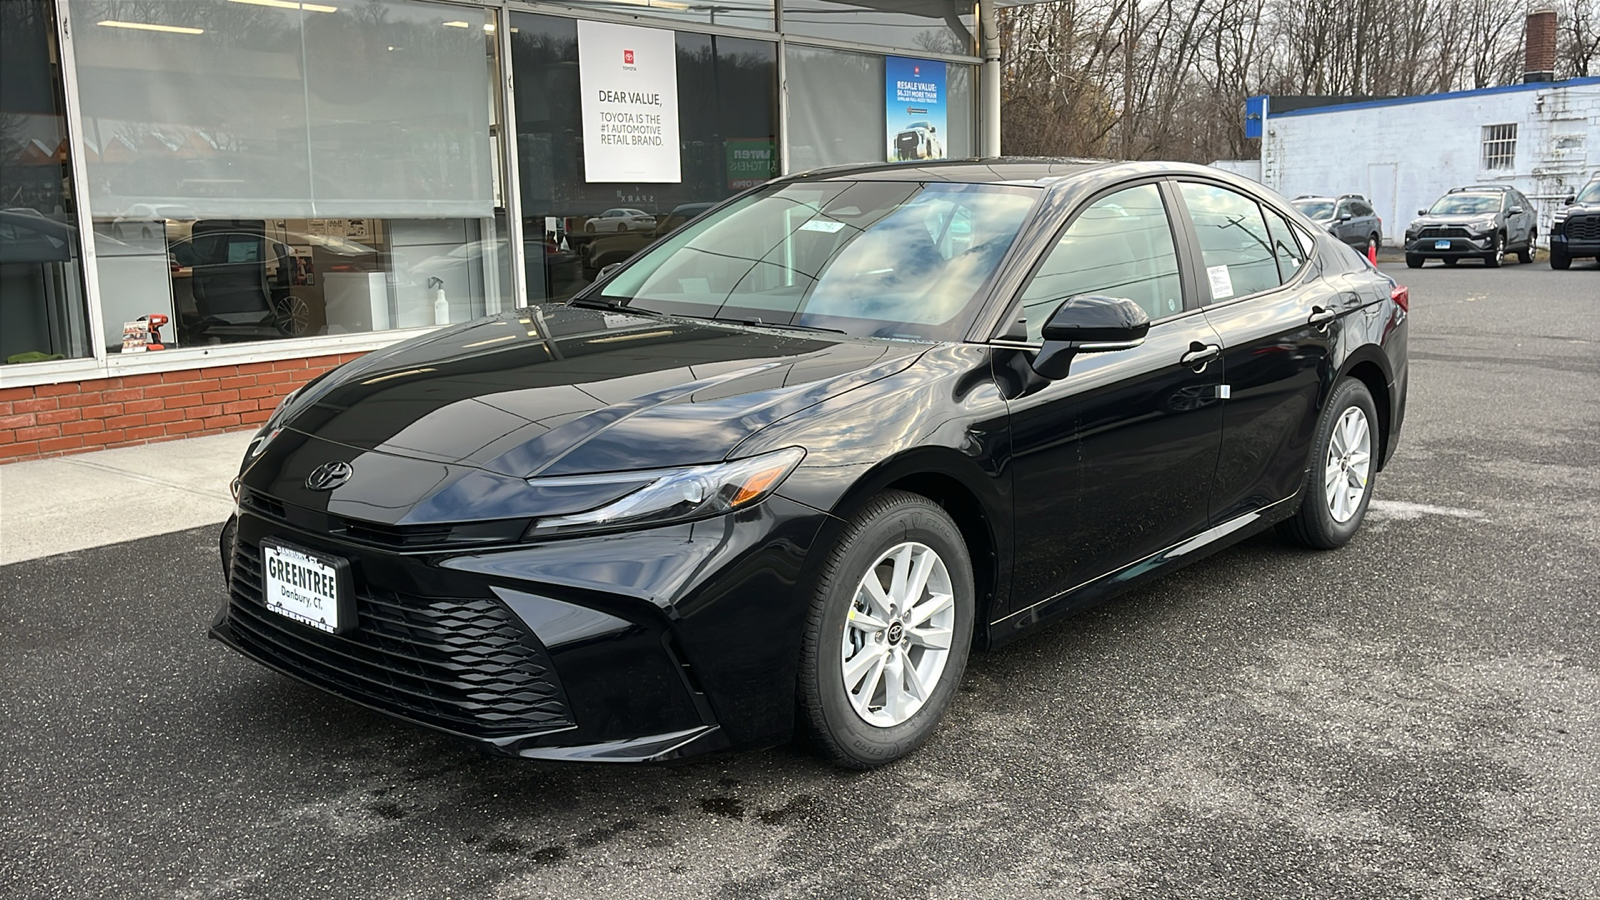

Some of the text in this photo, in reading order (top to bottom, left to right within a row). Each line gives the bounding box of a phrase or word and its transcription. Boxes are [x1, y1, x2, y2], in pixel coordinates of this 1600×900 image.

[897, 81, 937, 91] RESALE VALUE:
[598, 90, 662, 107] DEAR VALUE,
[600, 112, 661, 124] TOYOTA IS THE
[600, 124, 661, 135] #1 AUTOMOTIVE
[601, 134, 664, 147] RETAIL BRAND.
[269, 556, 335, 599] GREENTREE
[281, 585, 312, 608] Danbury,
[266, 603, 334, 634] GREENTREE
